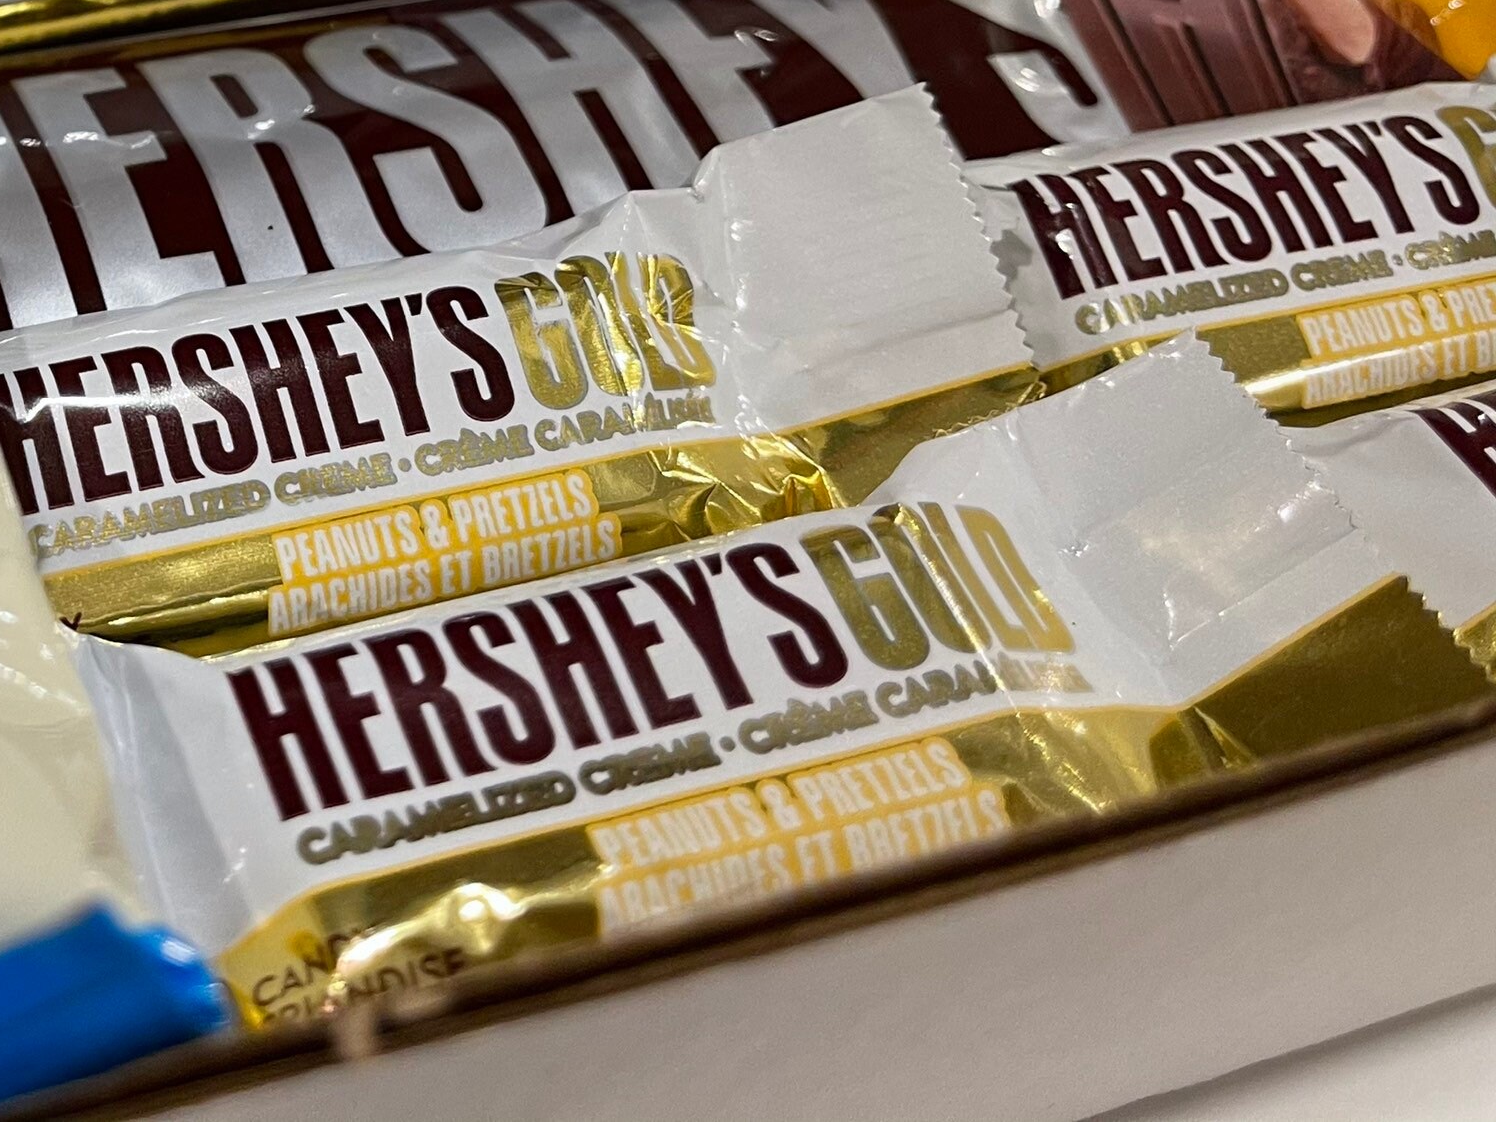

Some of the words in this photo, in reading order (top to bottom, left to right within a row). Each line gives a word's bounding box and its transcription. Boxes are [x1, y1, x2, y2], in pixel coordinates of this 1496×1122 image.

[1007, 115, 1481, 299] HERSHEY'S
[494, 250, 717, 410] GOLD
[1303, 299, 1425, 355] PEANUTS
[1421, 294, 1449, 332] &
[1442, 338, 1470, 377] ET
[269, 561, 434, 635] ARACHIDES
[440, 550, 475, 595] ET
[481, 519, 617, 586] BRETZELS
[275, 509, 420, 580] PEANUTS
[421, 504, 450, 549] &
[450, 473, 595, 543] PRETZELS
[224, 542, 849, 822] HERSHEY'S
[799, 502, 1075, 671] GOLD
[594, 792, 767, 868] PEANUTS
[761, 782, 802, 832] &
[798, 741, 967, 821] PRETZELS
